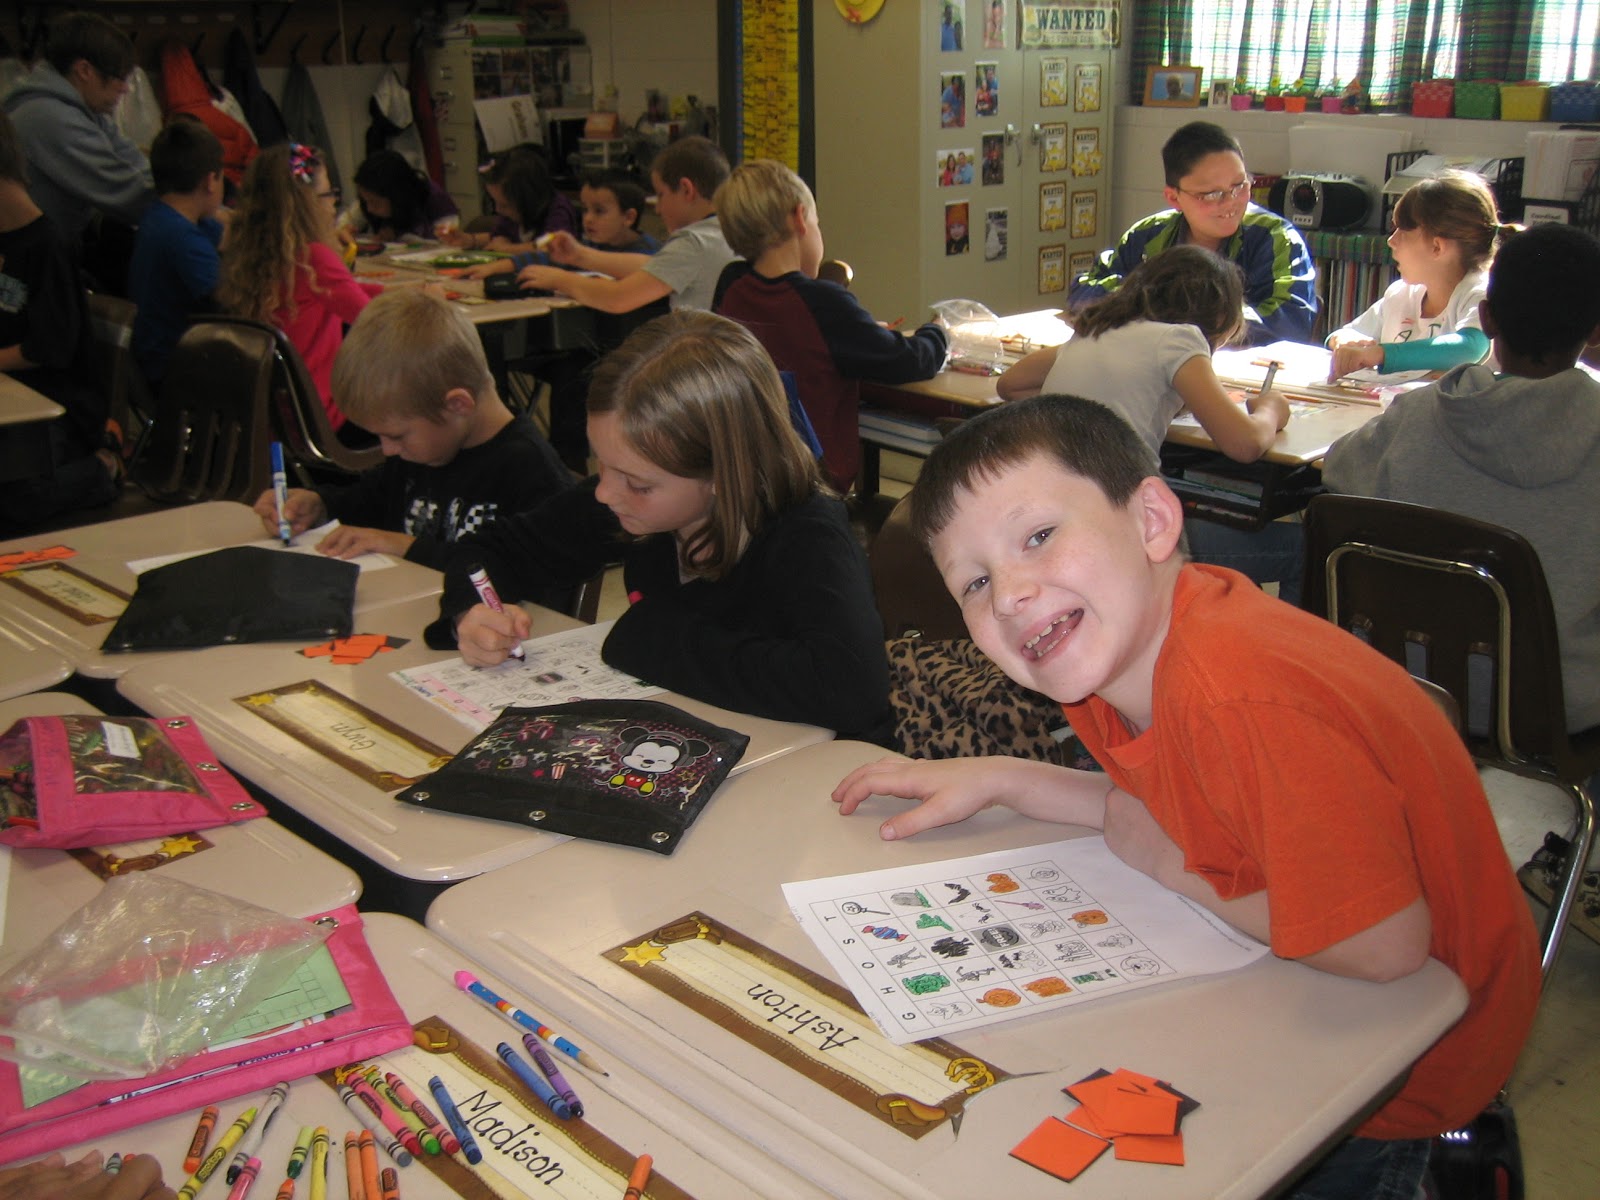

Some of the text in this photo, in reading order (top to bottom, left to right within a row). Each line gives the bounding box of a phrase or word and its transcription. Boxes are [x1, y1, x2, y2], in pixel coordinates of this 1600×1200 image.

[1036, 9, 1106, 30] WANTED
[331, 722, 376, 750] Gwyn
[988, 928, 1010, 948] FREE
[824, 914, 916, 1021] G H O S T
[747, 983, 859, 1051] Ashton
[456, 1090, 564, 1185] Madison
[199, 1149, 225, 1180] Crayola
